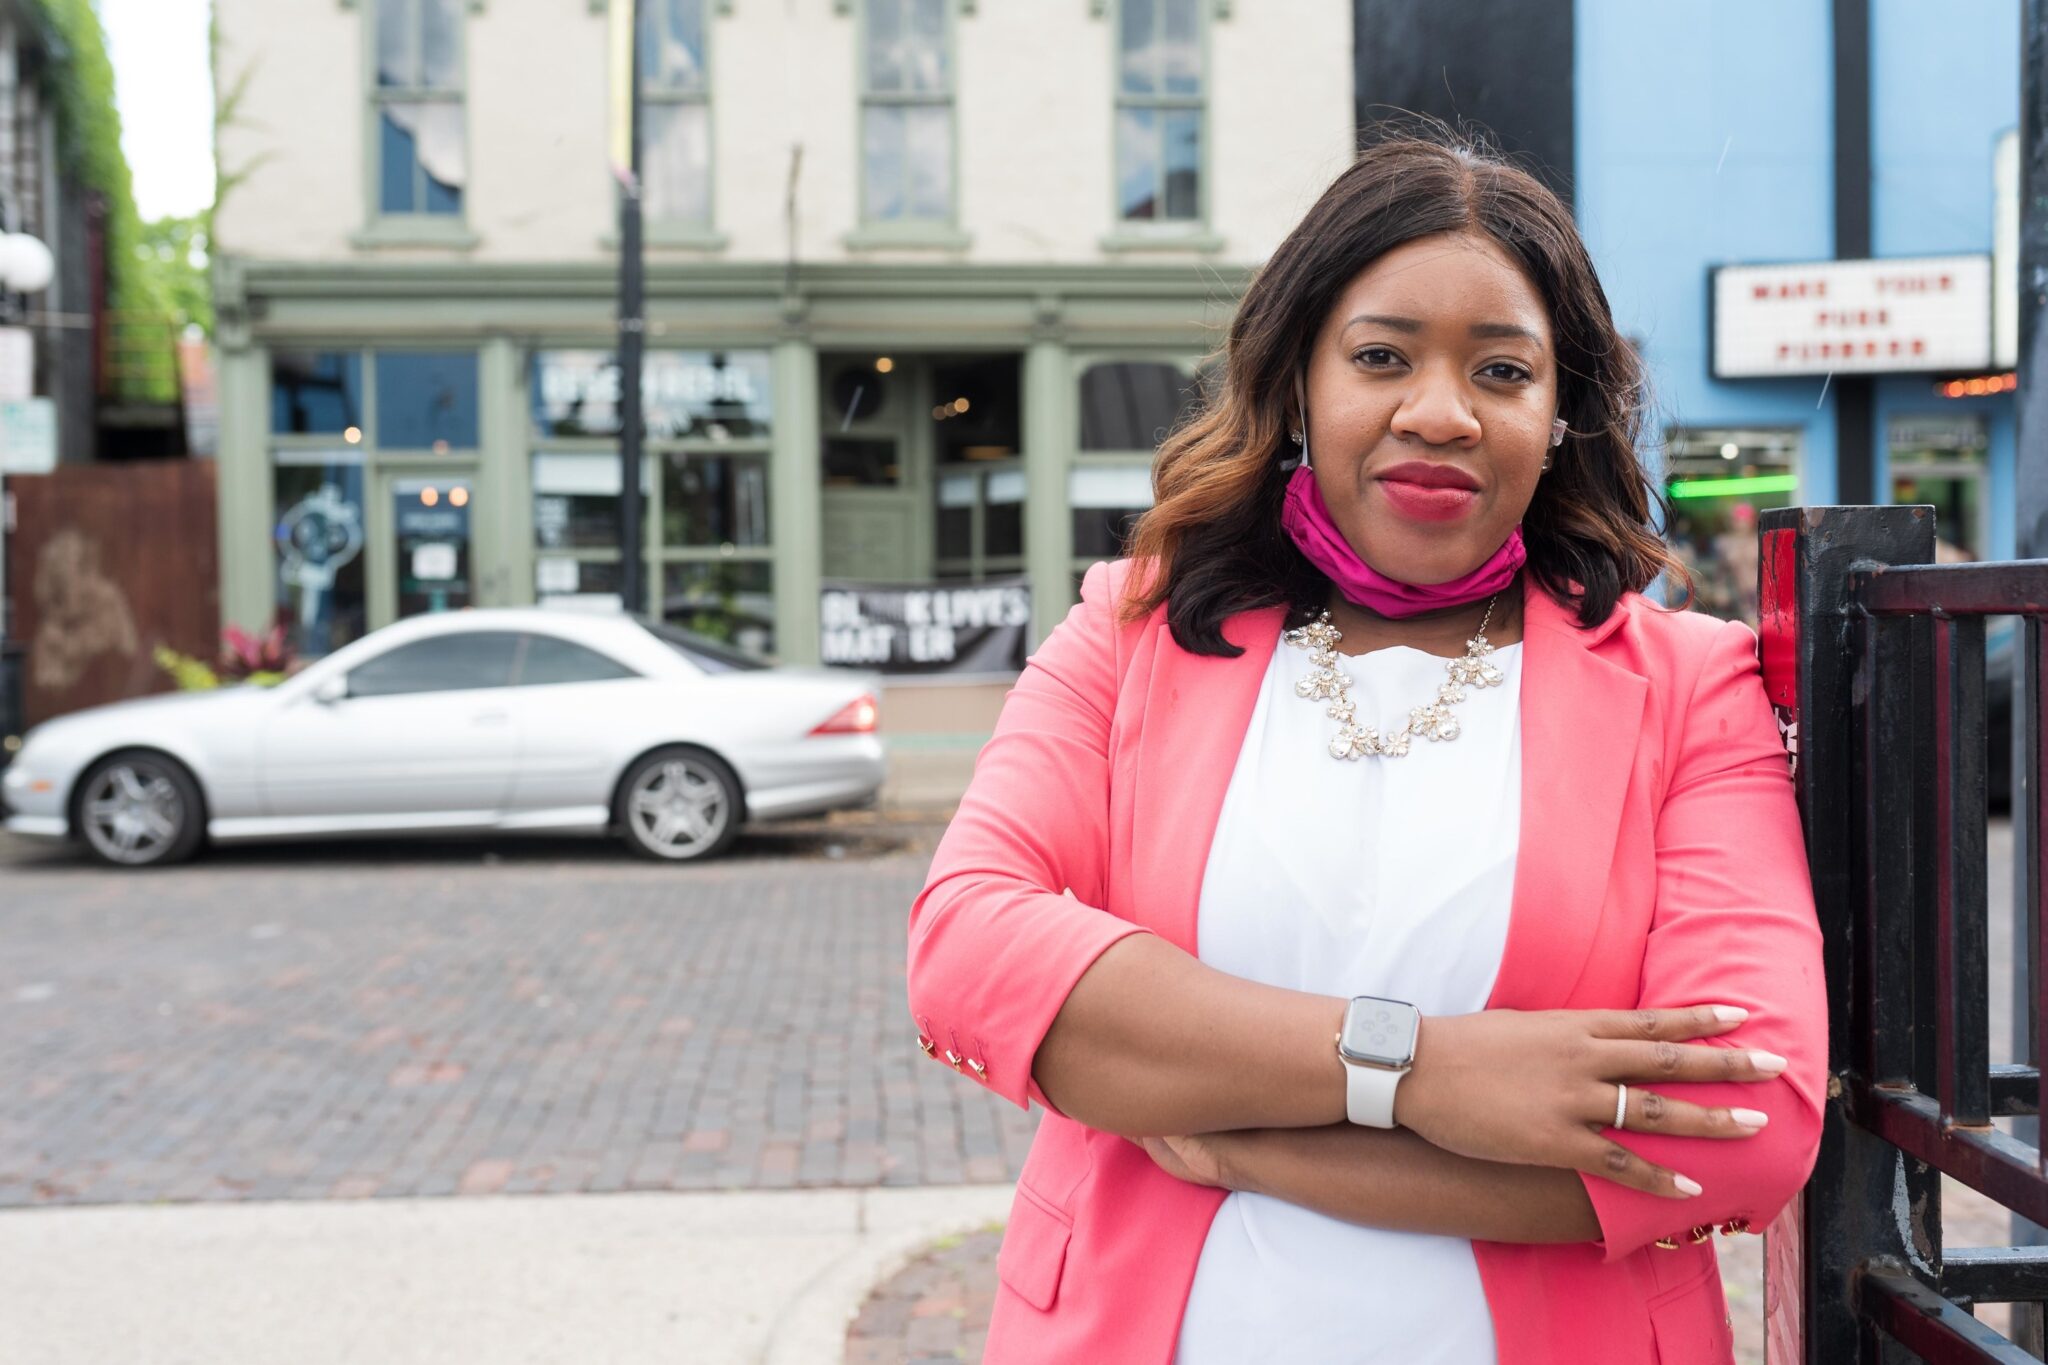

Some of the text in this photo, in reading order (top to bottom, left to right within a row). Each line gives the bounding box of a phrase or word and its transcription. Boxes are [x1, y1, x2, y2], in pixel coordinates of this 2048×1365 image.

[1751, 272, 1953, 301] MAKE YOUR
[822, 587, 1031, 627] BLK LIVES
[821, 624, 956, 663] MATER
